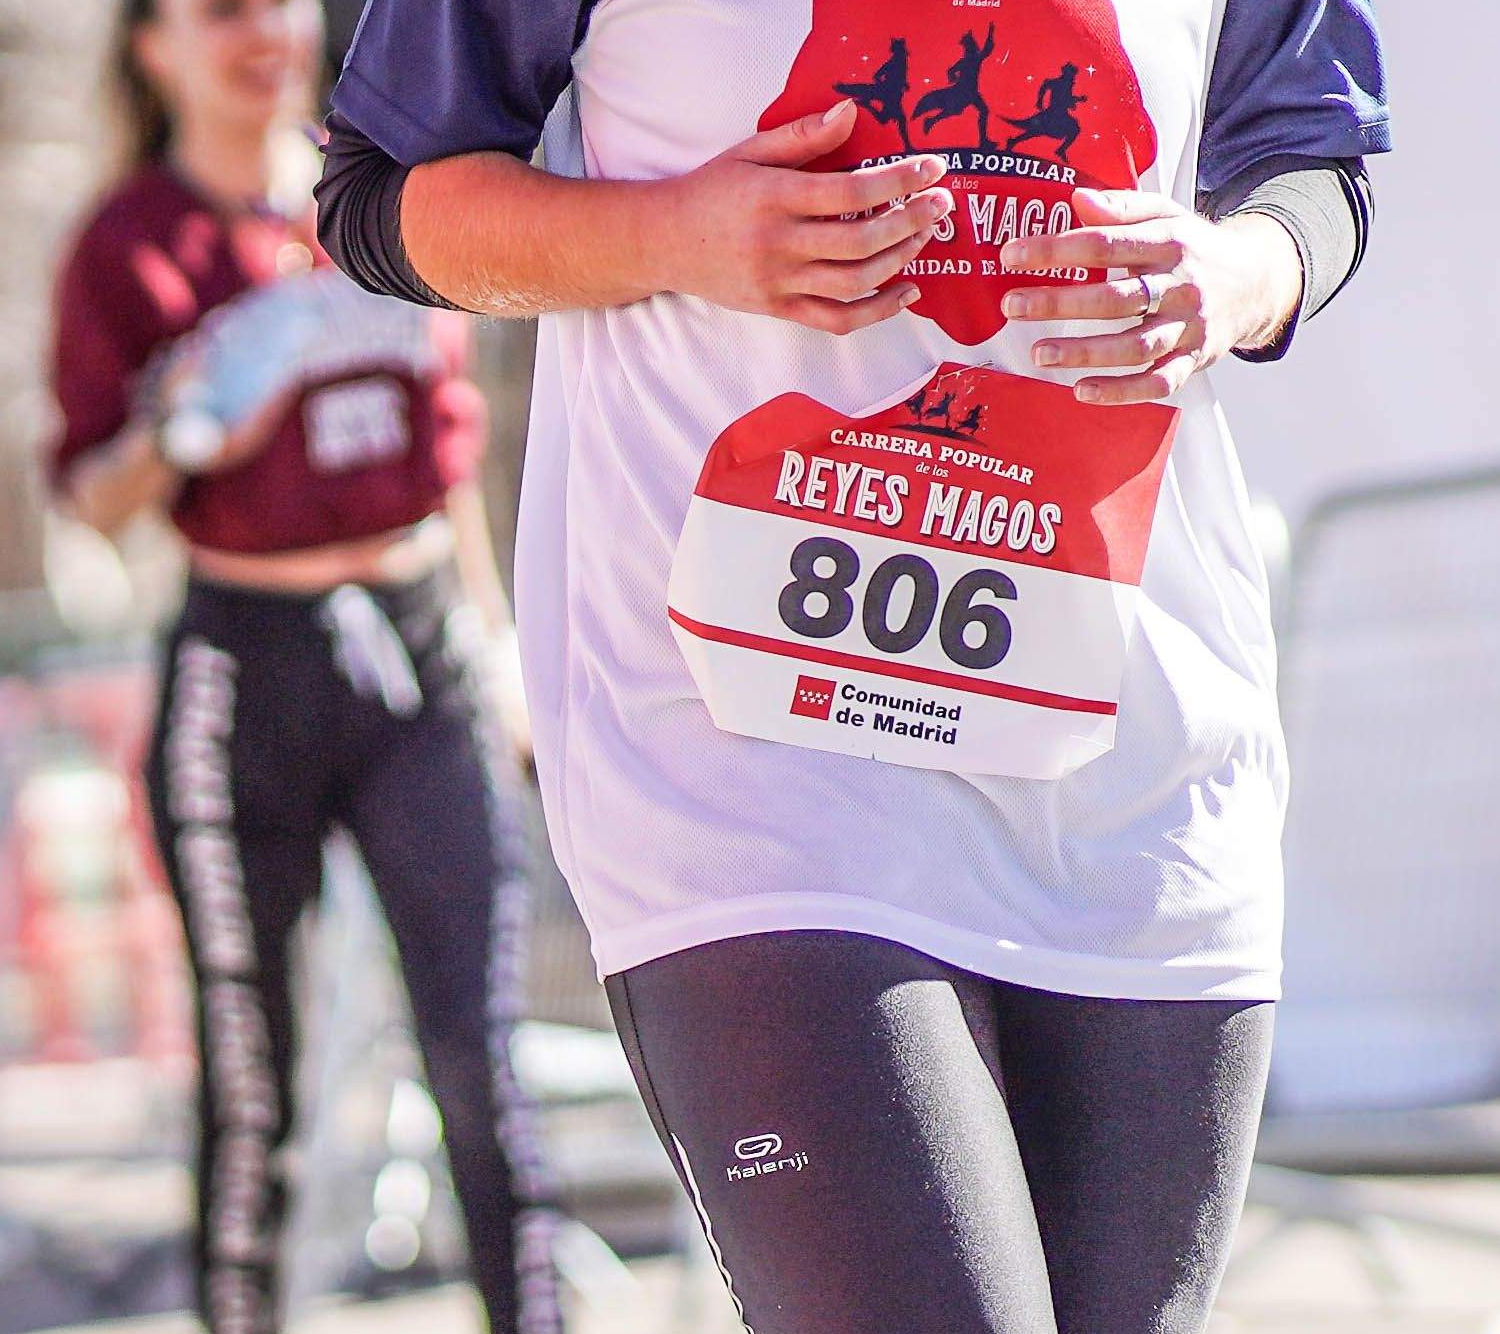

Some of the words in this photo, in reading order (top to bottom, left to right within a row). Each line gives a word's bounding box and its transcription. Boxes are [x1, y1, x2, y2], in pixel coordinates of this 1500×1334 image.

[970, 153, 1076, 185] POPULAR
[967, 193, 1072, 246] MAGO
[903, 259, 972, 275] NIDAD
[830, 428, 933, 459] CARRERA
[939, 445, 1035, 486] POPULAR
[915, 461, 930, 474] de
[933, 464, 949, 478] los
[774, 450, 909, 526] REYES
[920, 481, 1062, 554] MAGOS
[778, 536, 1018, 670] 806
[841, 683, 962, 722] Comunidad
[836, 707, 865, 727] de
[872, 712, 957, 745] Madrid
[726, 1151, 809, 1182] Kalenji
